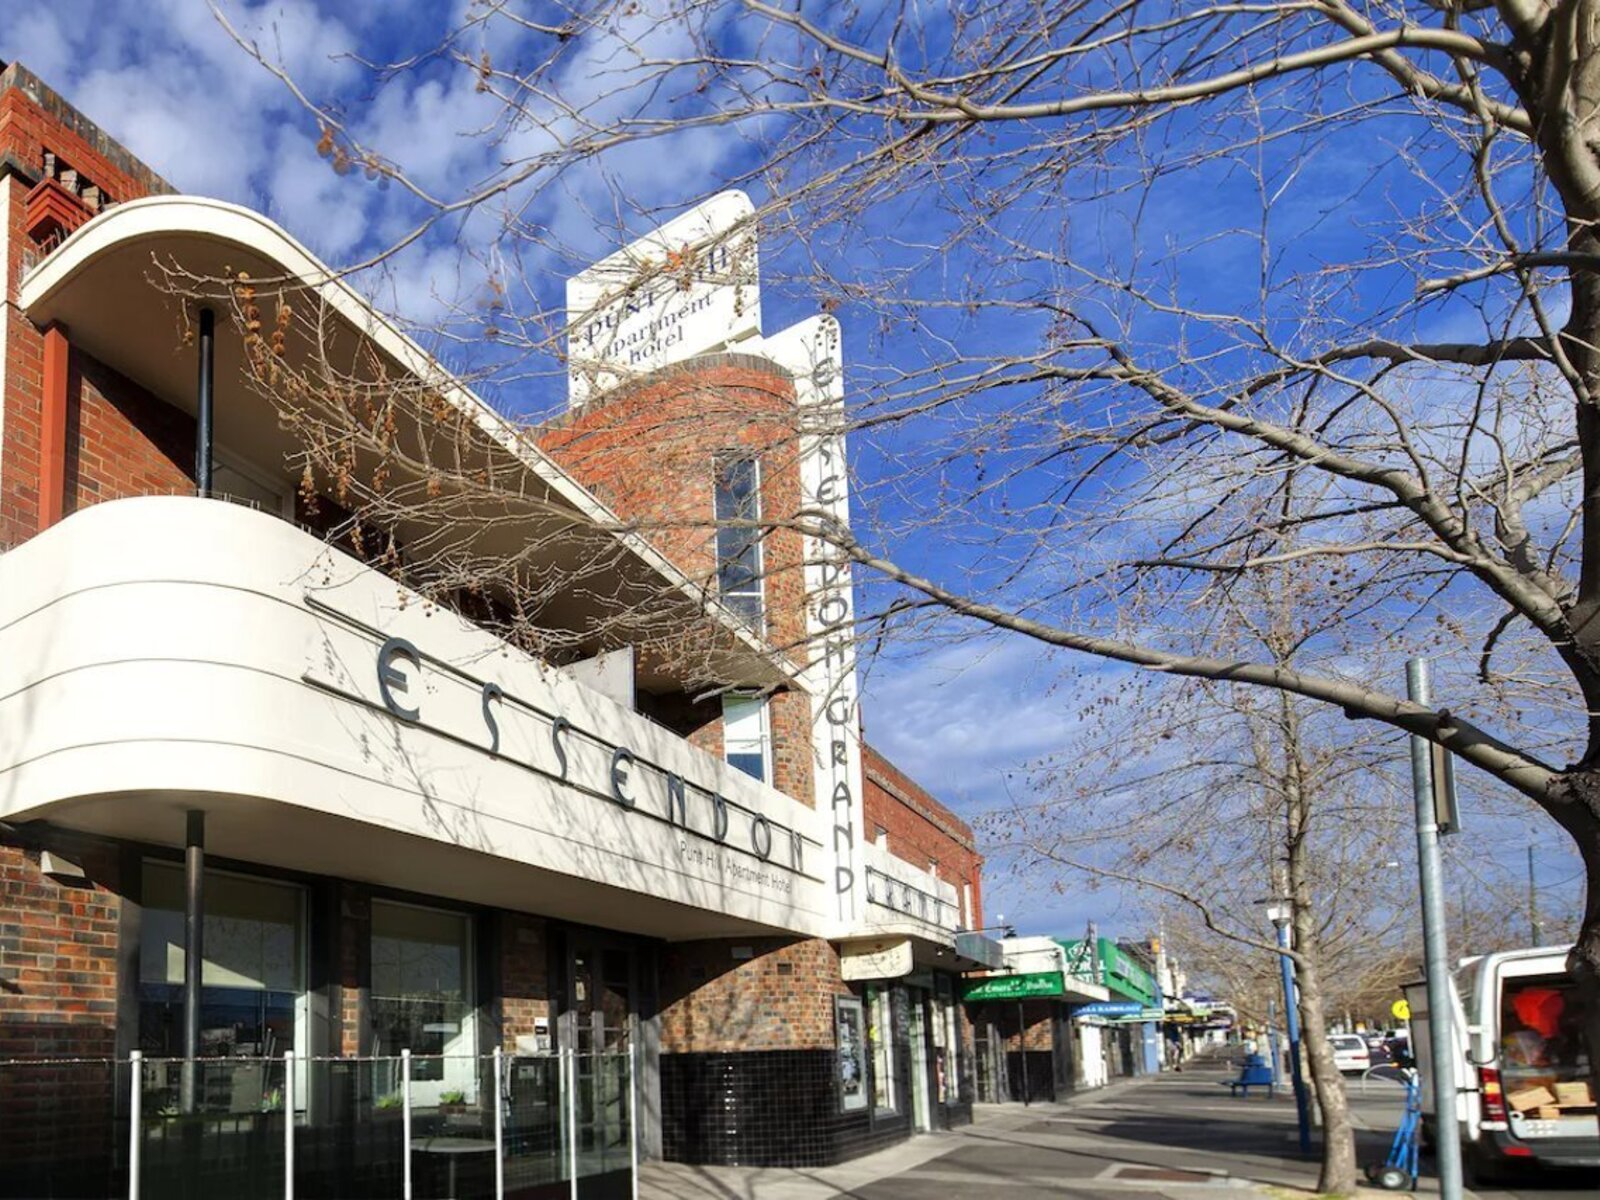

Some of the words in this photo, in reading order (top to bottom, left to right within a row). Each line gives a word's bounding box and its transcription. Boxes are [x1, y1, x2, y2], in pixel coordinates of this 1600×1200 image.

[629, 325, 684, 366] hotel
[811, 356, 848, 669] ESEDON
[376, 637, 803, 873] ESSENDON
[825, 695, 855, 895] GRAND
